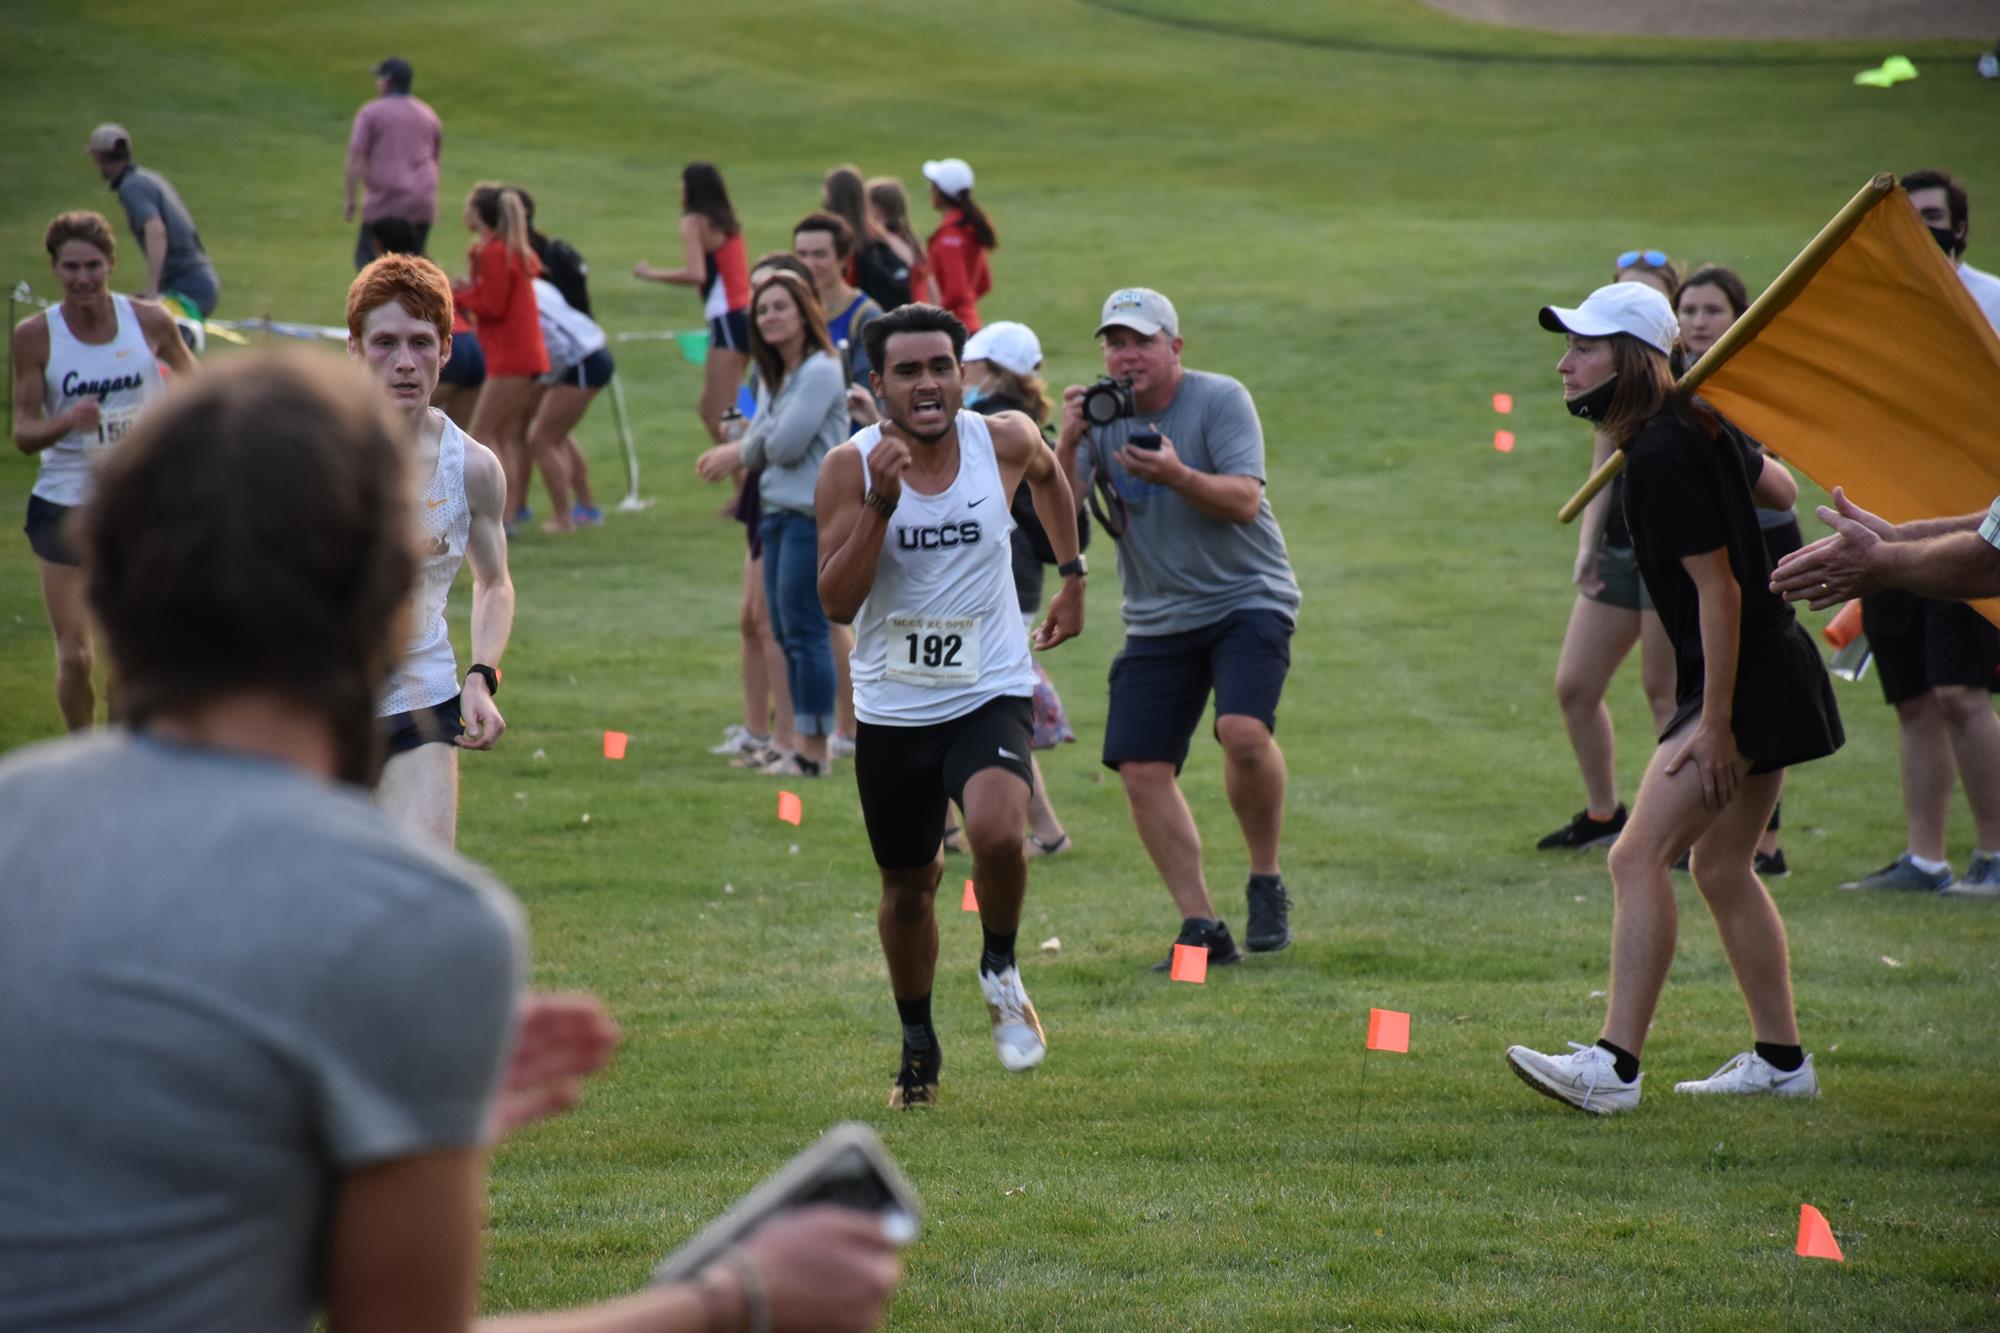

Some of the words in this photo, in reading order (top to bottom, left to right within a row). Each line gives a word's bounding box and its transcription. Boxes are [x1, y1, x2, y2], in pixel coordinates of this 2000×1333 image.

[62, 371, 143, 403] Cougars
[898, 521, 981, 550] UCCS
[906, 632, 963, 667] 192
